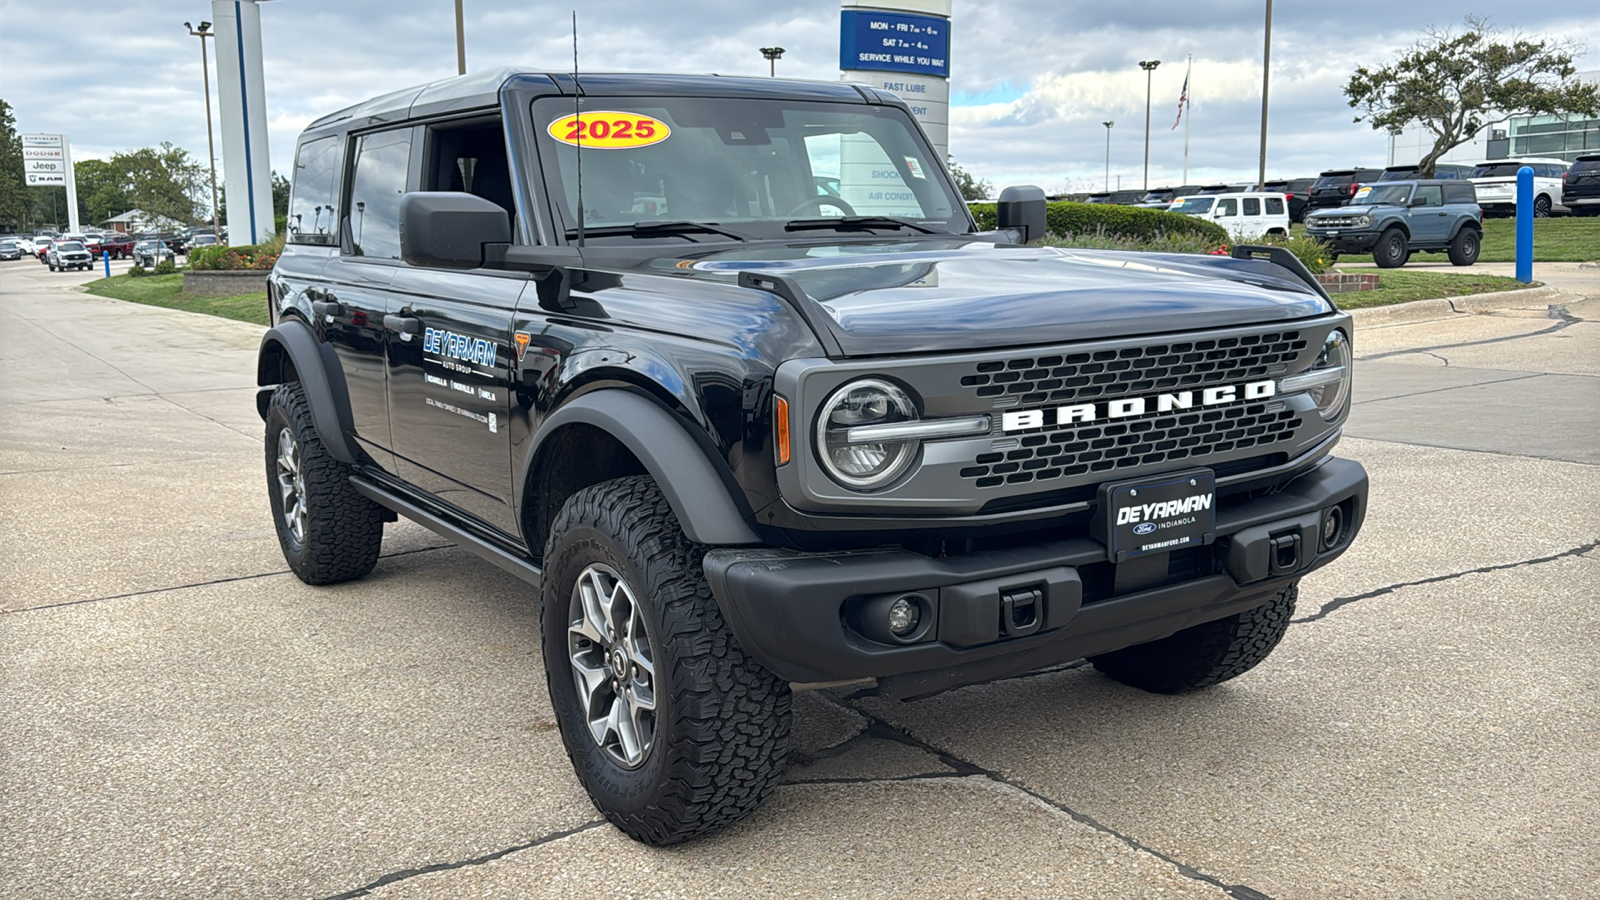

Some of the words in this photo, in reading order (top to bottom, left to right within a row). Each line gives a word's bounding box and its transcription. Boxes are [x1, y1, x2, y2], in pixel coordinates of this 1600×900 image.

[870, 21, 888, 30] MON
[896, 23, 908, 32] FRI
[882, 38, 896, 47] SAT
[859, 52, 892, 62] SERVICE
[894, 55, 915, 64] WHILE
[917, 57, 930, 66] YOU
[932, 58, 945, 68] WAIT
[884, 82, 904, 92] FAST
[906, 84, 926, 94] LUBE
[910, 106, 927, 115] ENT
[564, 120, 656, 140] 2025
[32, 162, 56, 171] Jeep
[868, 192, 883, 200] AIR
[884, 192, 916, 200] CONDIT
[423, 327, 498, 368] DEYARMAN
[442, 360, 455, 370] AUTO
[456, 364, 472, 374] GROUP
[1002, 380, 1276, 432] BRONCO
[1116, 492, 1212, 526] DEYARMAN
[1158, 516, 1196, 530] INDIANOLA
[1142, 536, 1190, 552] DEYARMANFORD.COM
